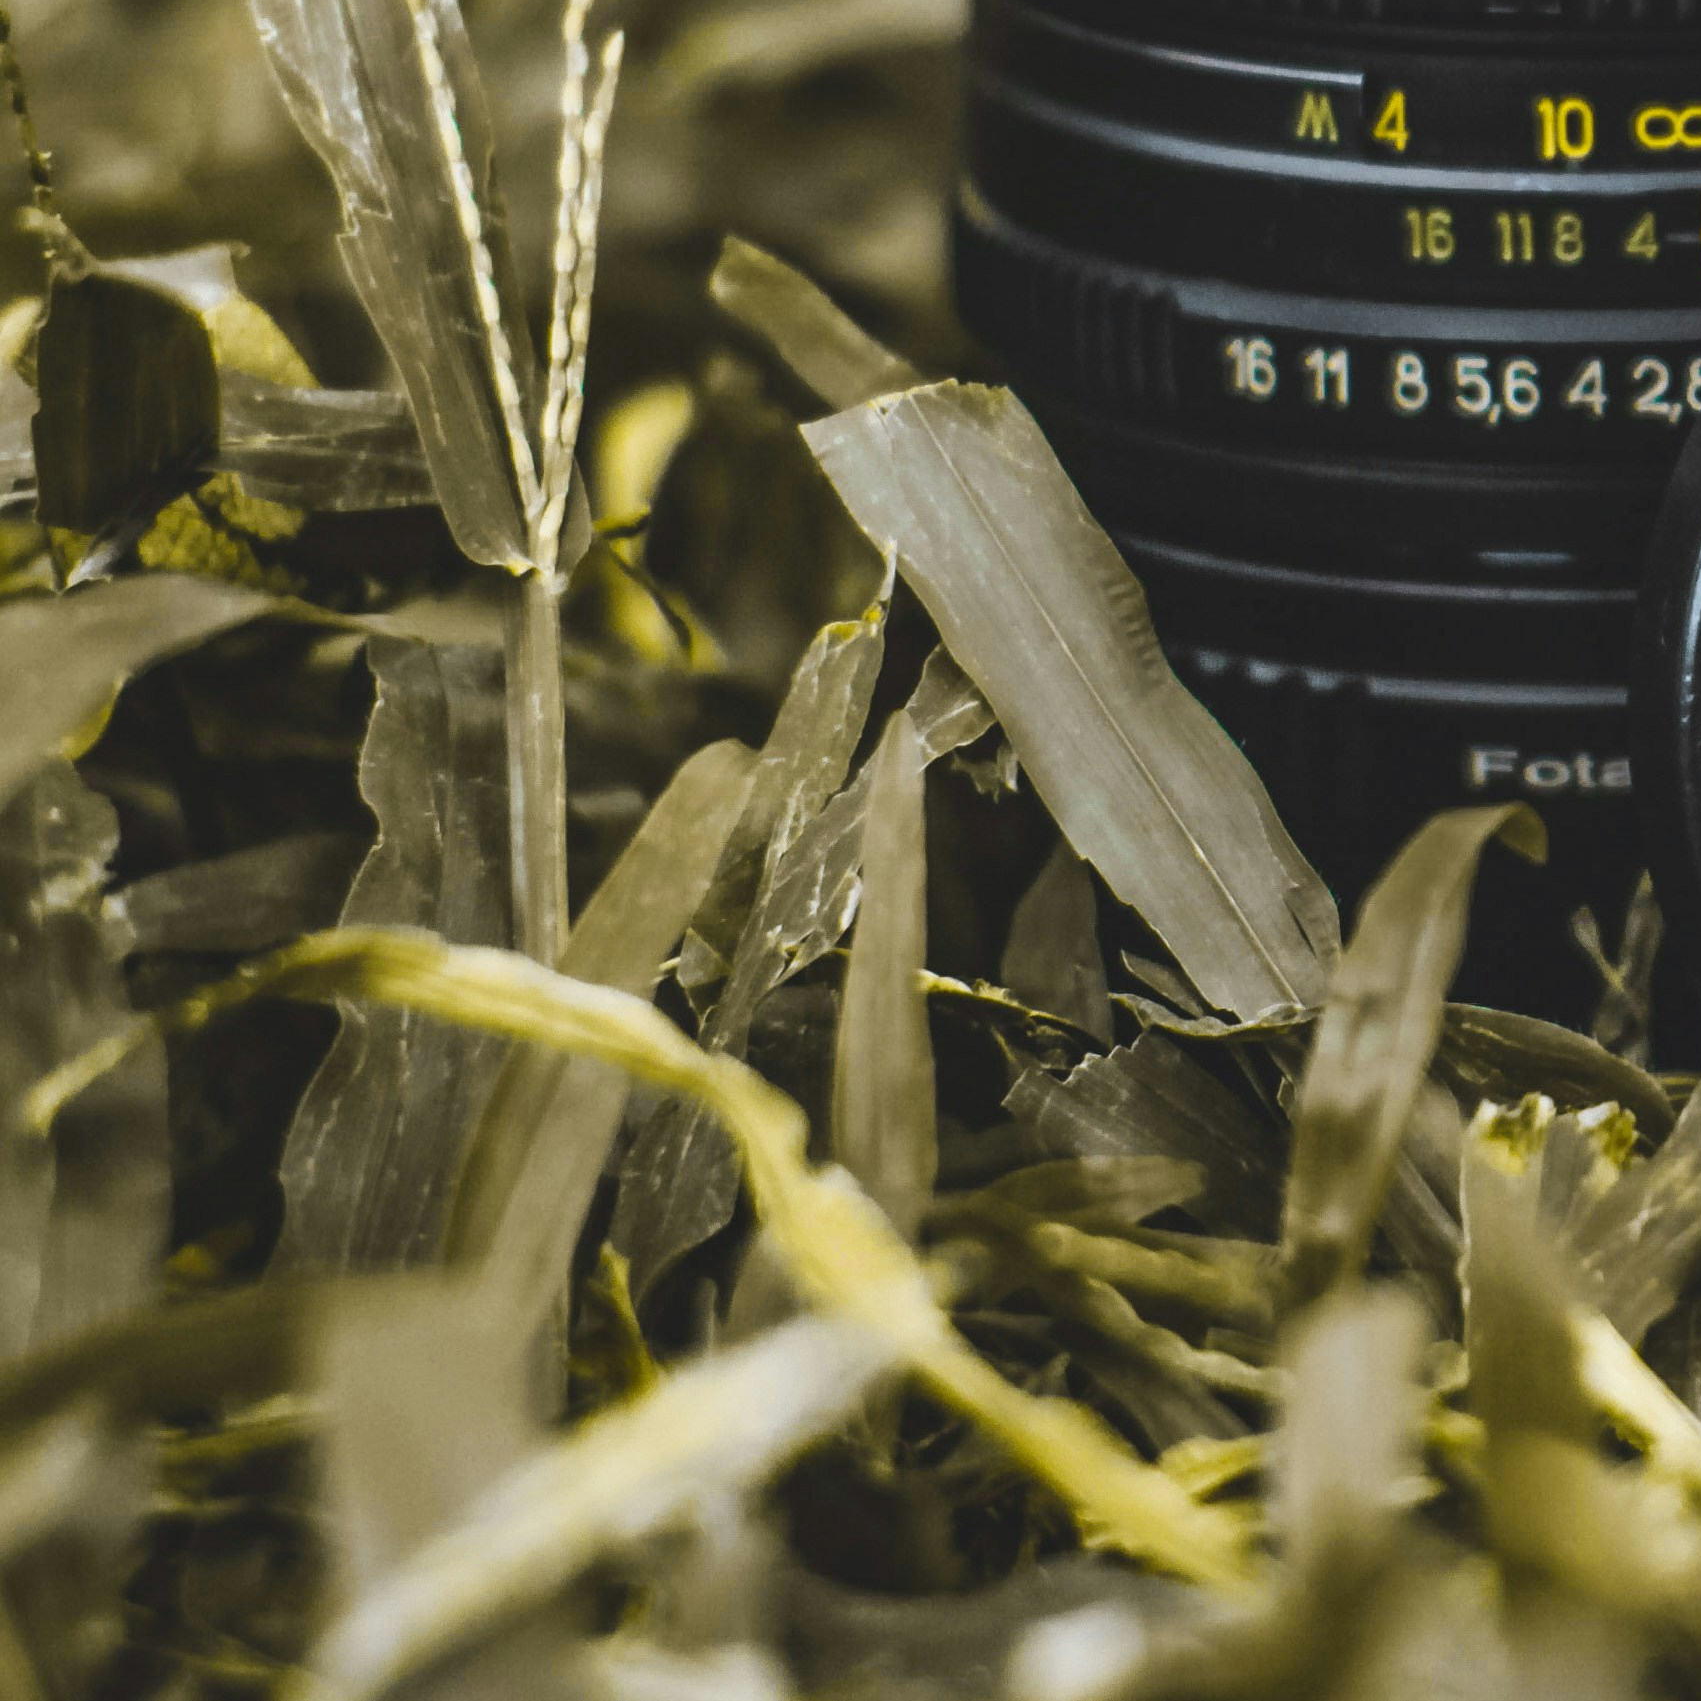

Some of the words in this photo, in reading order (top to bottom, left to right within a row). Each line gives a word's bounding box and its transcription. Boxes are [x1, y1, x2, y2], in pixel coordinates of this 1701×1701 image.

[1373, 90, 1409, 151] 4
[1536, 97, 1594, 160] 10
[1405, 208, 1455, 262] 16
[1496, 212, 1534, 263] 11
[1552, 213, 1584, 264] 8
[1624, 212, 1659, 259] 4
[1225, 338, 1277, 396] 16
[1304, 348, 1350, 404] 11
[1393, 353, 1429, 411] 8
[1454, 355, 1541, 424] 5,6
[1566, 360, 1607, 415] 4
